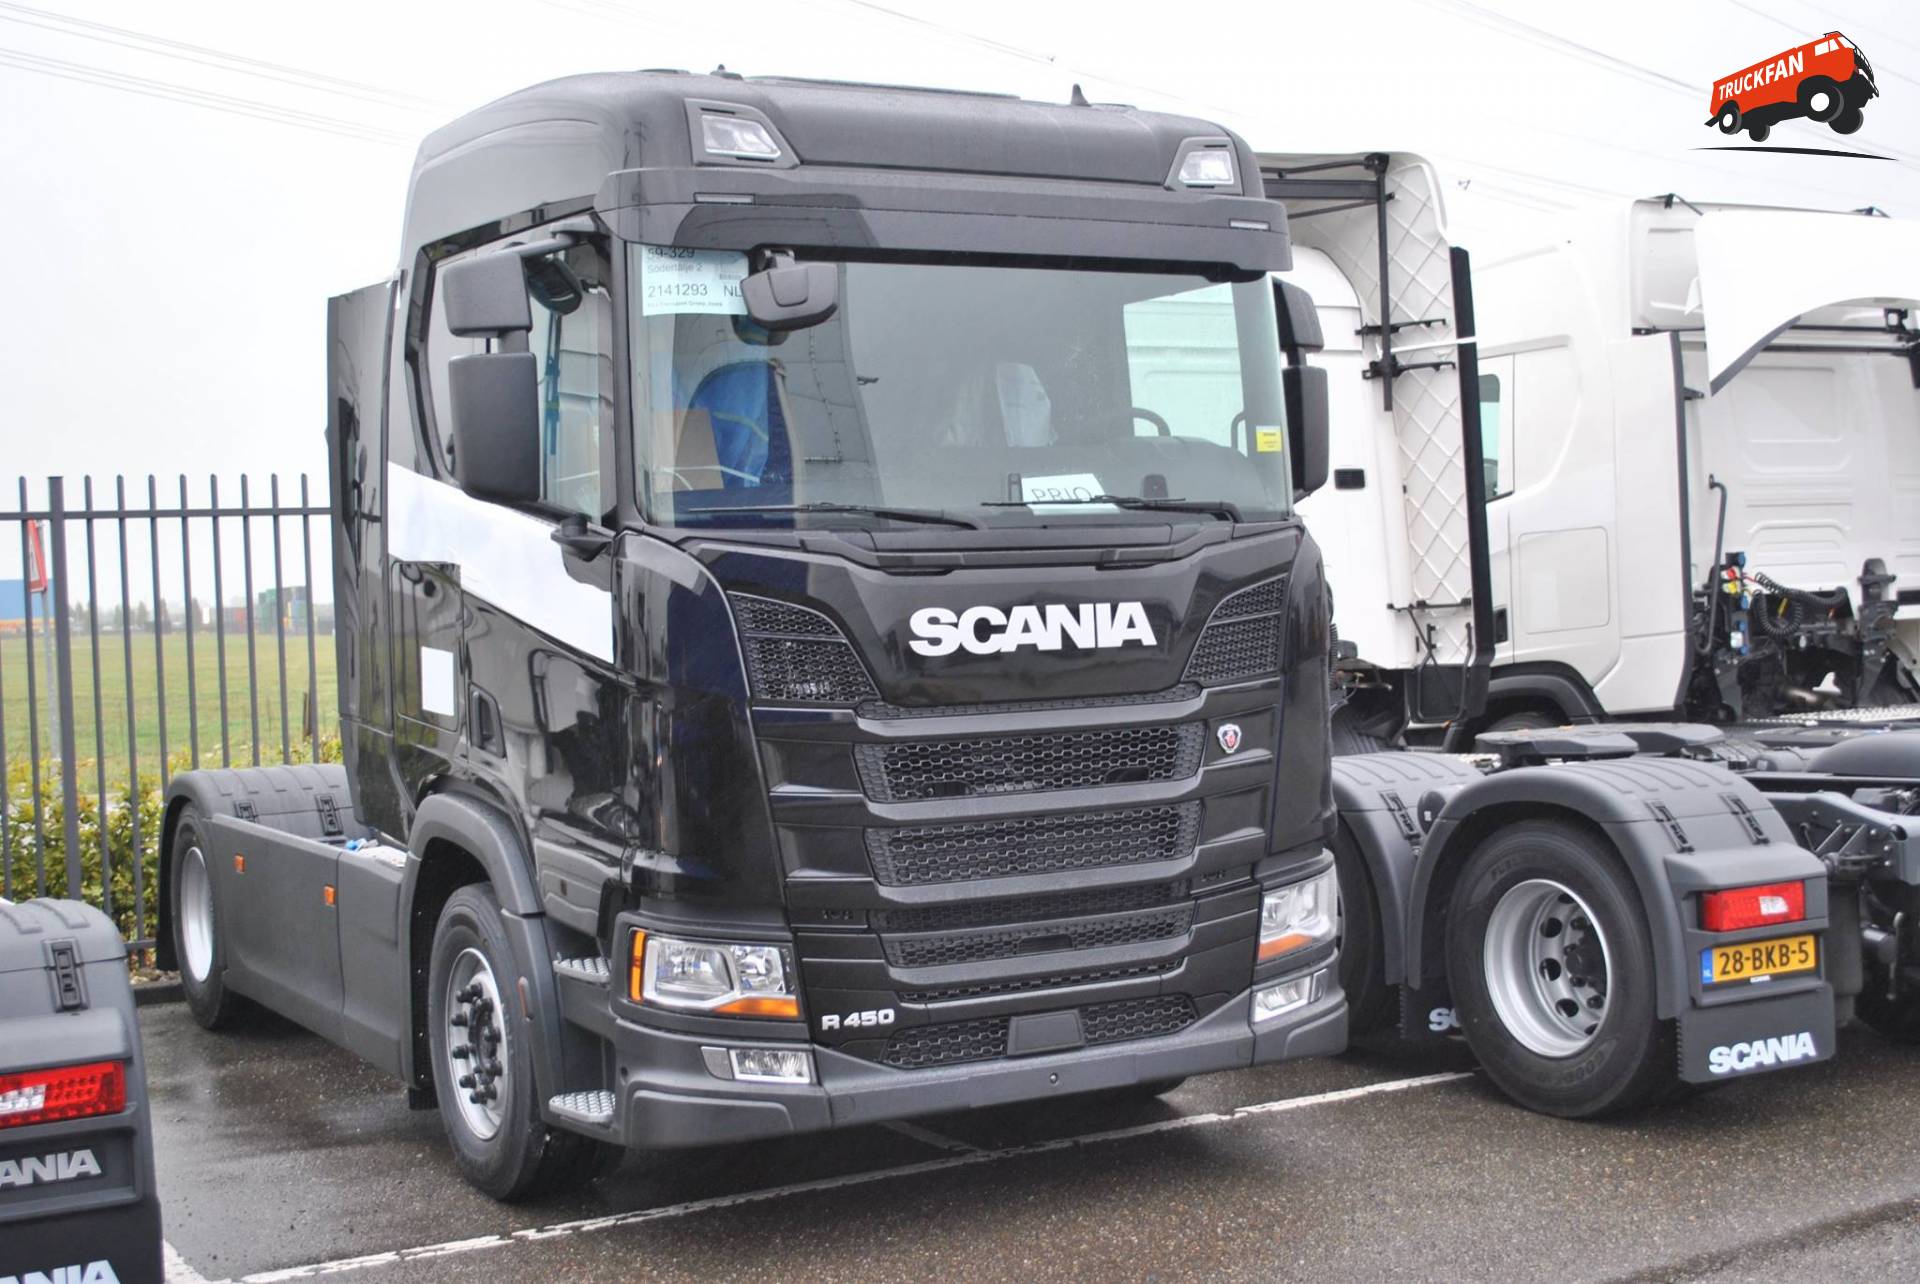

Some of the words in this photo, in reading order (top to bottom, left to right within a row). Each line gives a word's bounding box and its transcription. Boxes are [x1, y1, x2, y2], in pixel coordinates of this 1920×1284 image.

[648, 283, 708, 298] 2141293
[908, 601, 1158, 657] SCANIA
[1720, 941, 1809, 976] 28-BKB-5
[822, 1014, 840, 1031] R
[843, 1008, 895, 1028] 450
[1708, 1031, 1816, 1074] SCANIA
